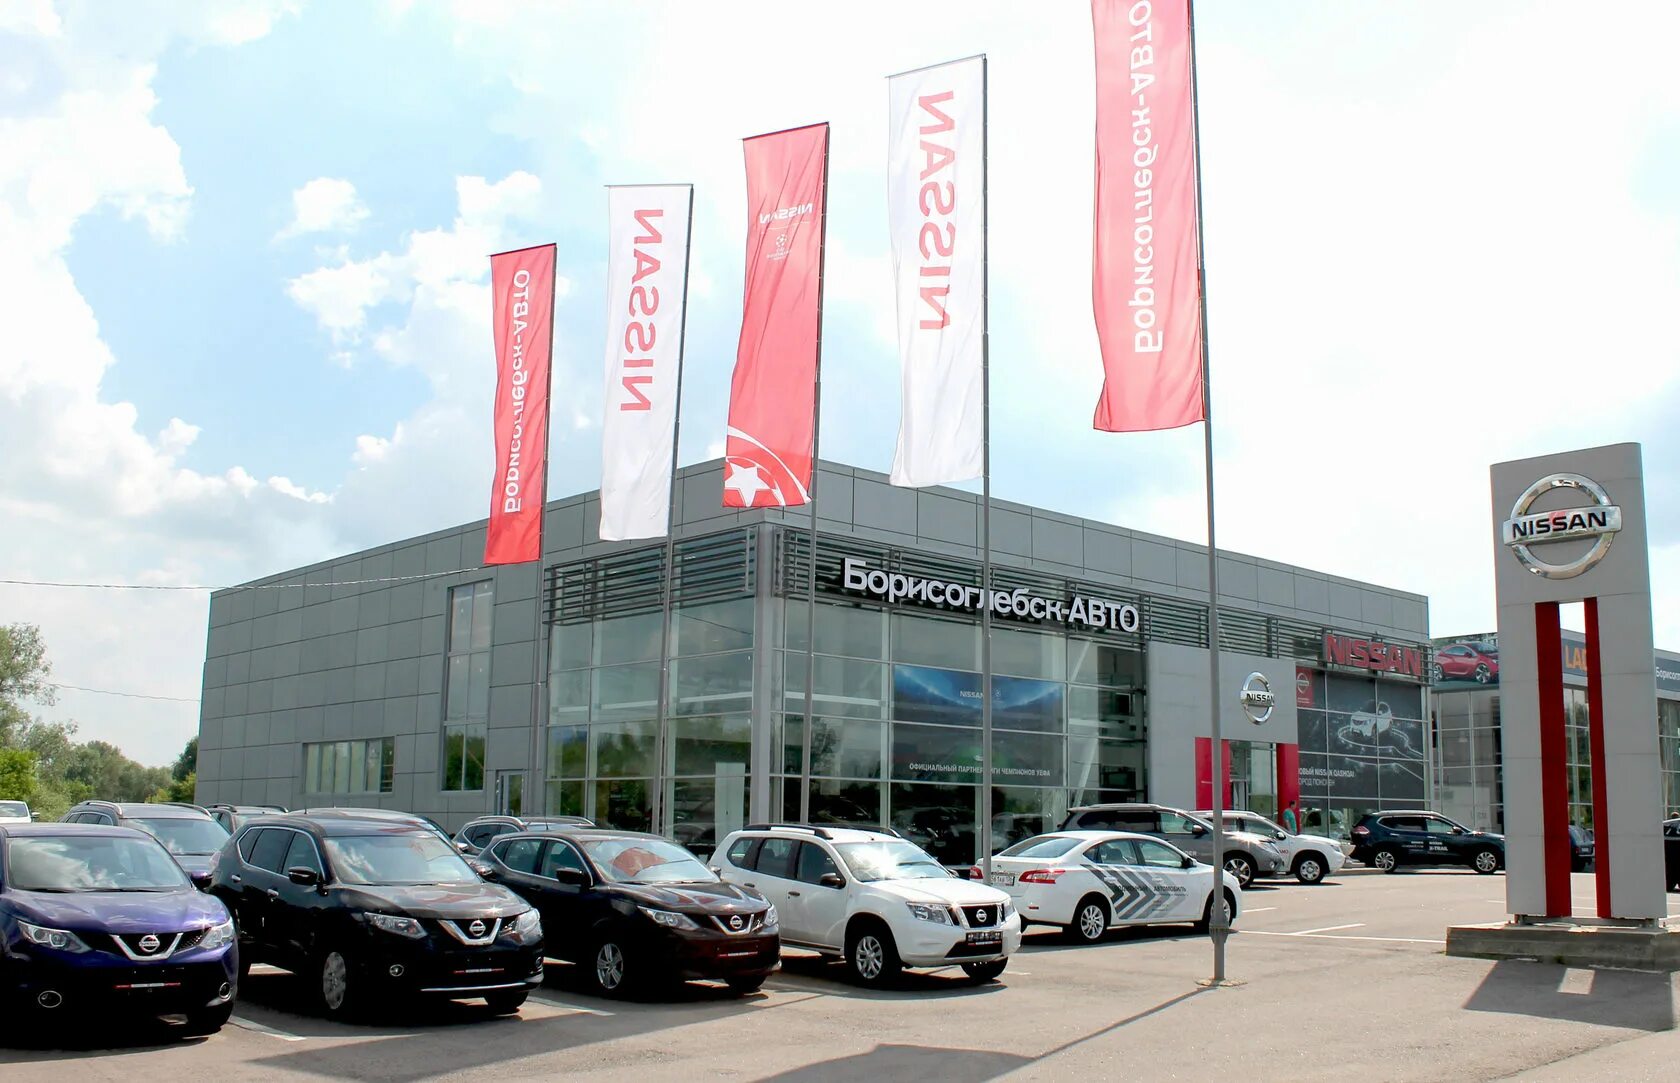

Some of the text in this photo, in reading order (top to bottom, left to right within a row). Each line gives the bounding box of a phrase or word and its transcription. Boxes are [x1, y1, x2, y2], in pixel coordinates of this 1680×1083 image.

[1512, 511, 1607, 539] NISSAN
[843, 557, 1140, 633] Борисоглебск-АВТО
[1325, 634, 1421, 676] NISSAN
[1565, 644, 1587, 673] LAD
[909, 763, 957, 772] ОФИЦИАЛЬНЫЙ
[1001, 767, 1035, 776] ЧЕМПИОНОВ
[1036, 769, 1050, 777] УЕФА
[1298, 766, 1314, 775] ОВЫЙ
